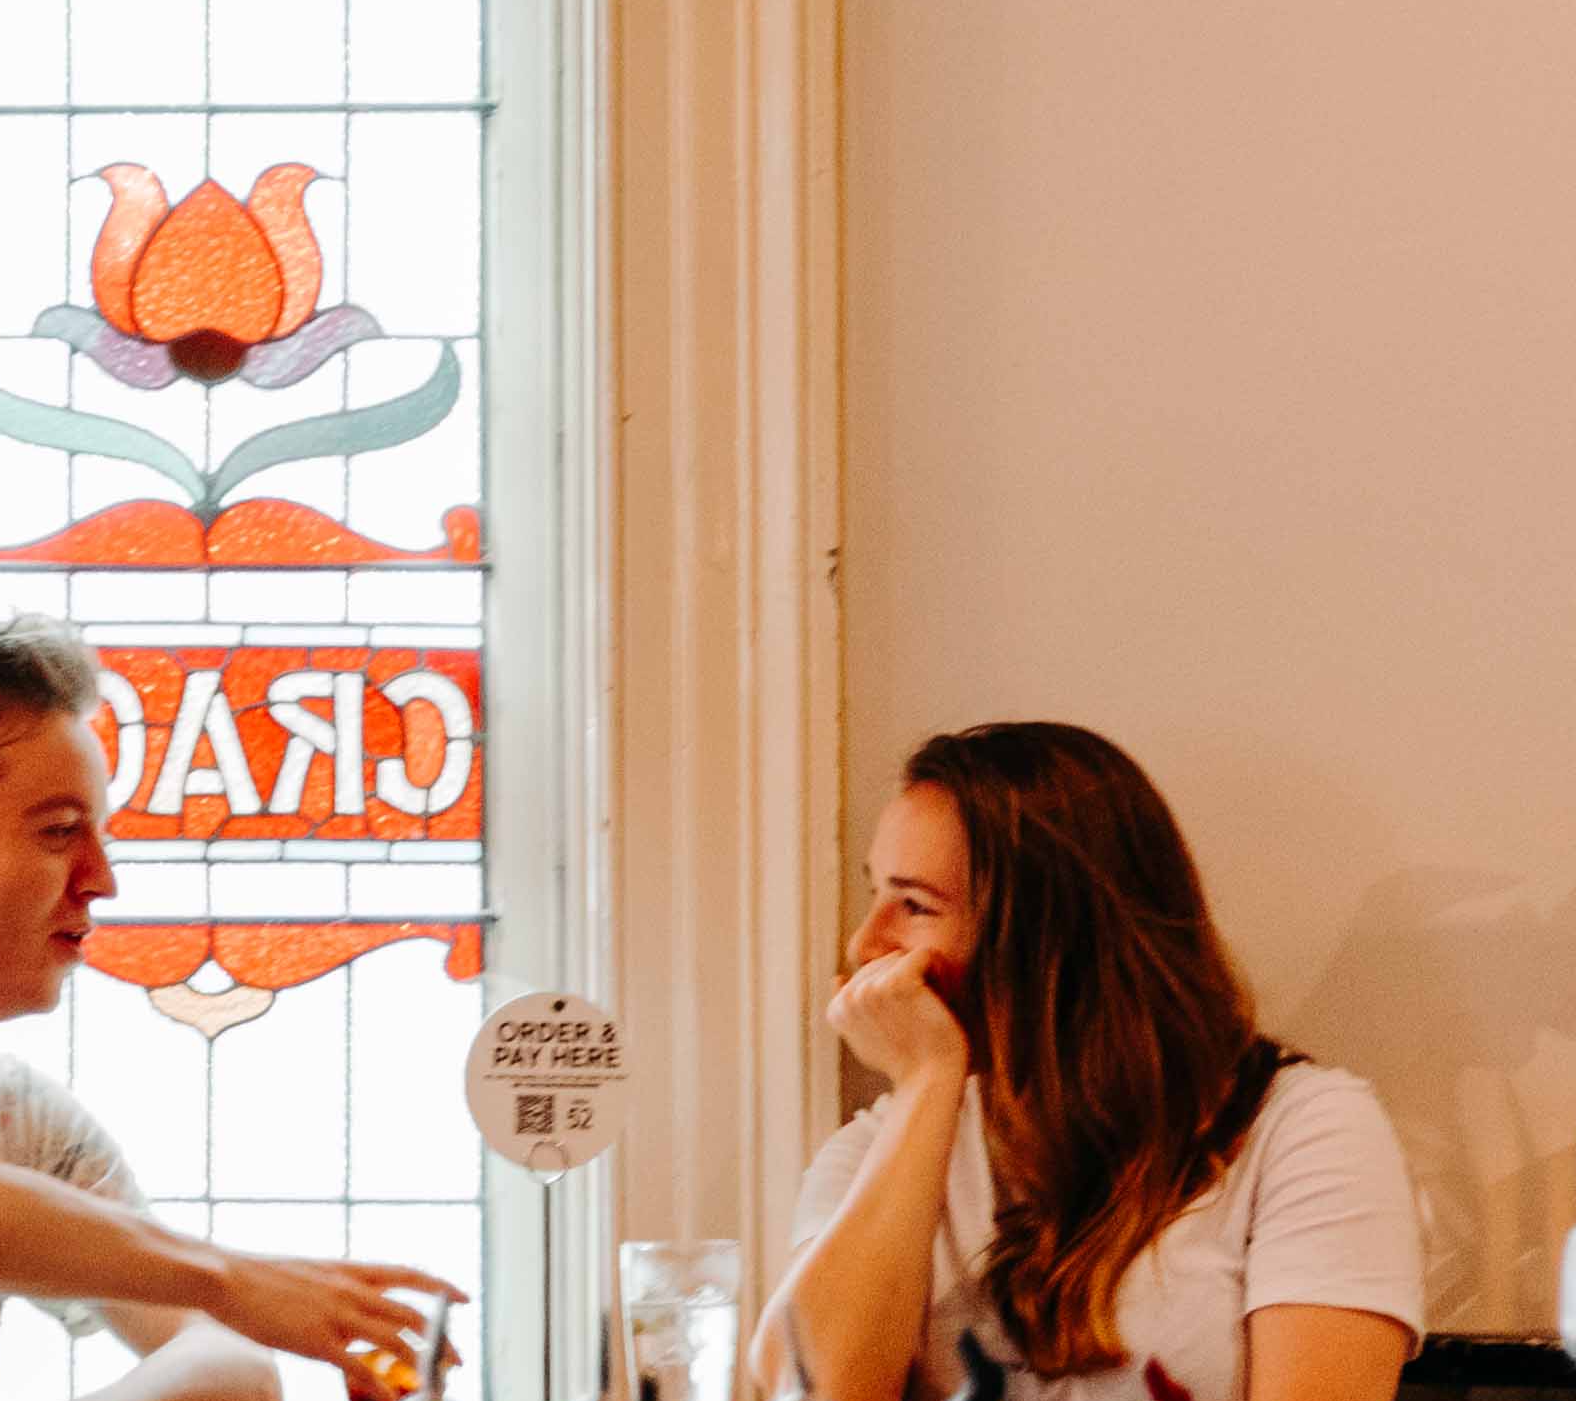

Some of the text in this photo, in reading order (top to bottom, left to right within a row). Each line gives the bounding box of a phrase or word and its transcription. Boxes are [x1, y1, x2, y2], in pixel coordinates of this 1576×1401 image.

[497, 1021, 616, 1043] ORDER &
[492, 1046, 623, 1069] PAY HERE
[566, 1106, 594, 1130] 52
